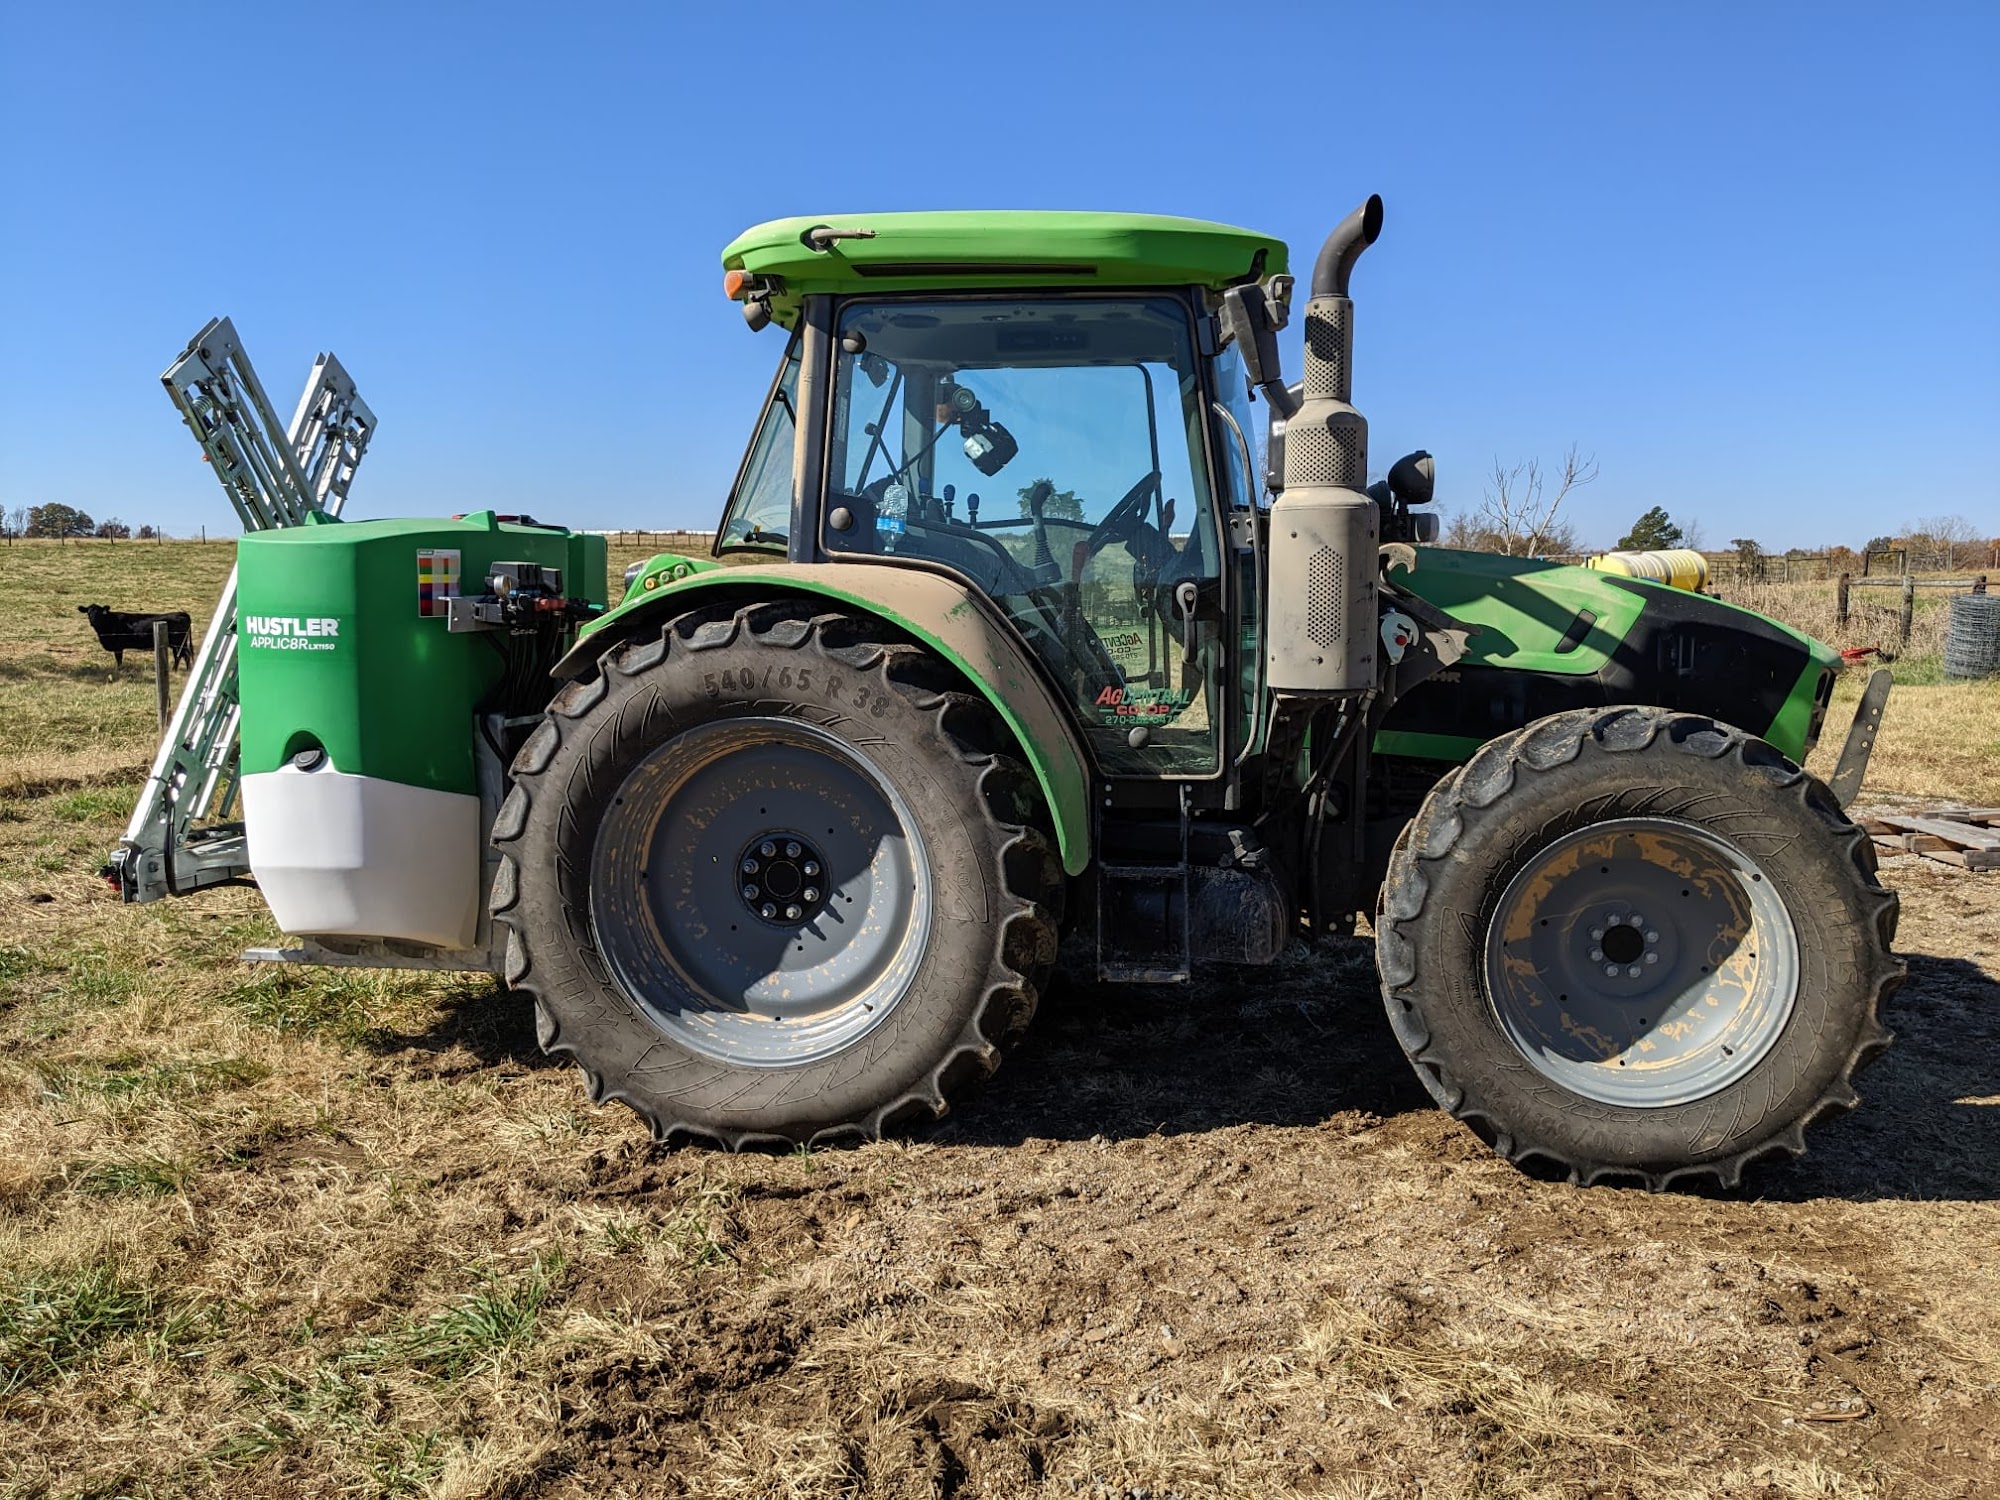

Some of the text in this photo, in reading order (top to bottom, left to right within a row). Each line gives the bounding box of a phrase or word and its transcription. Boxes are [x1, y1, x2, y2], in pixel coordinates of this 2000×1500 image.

[246, 616, 339, 636] HUSTLER
[250, 636, 309, 650] APPLIC8R
[704, 665, 891, 718] 540/65 R 38
